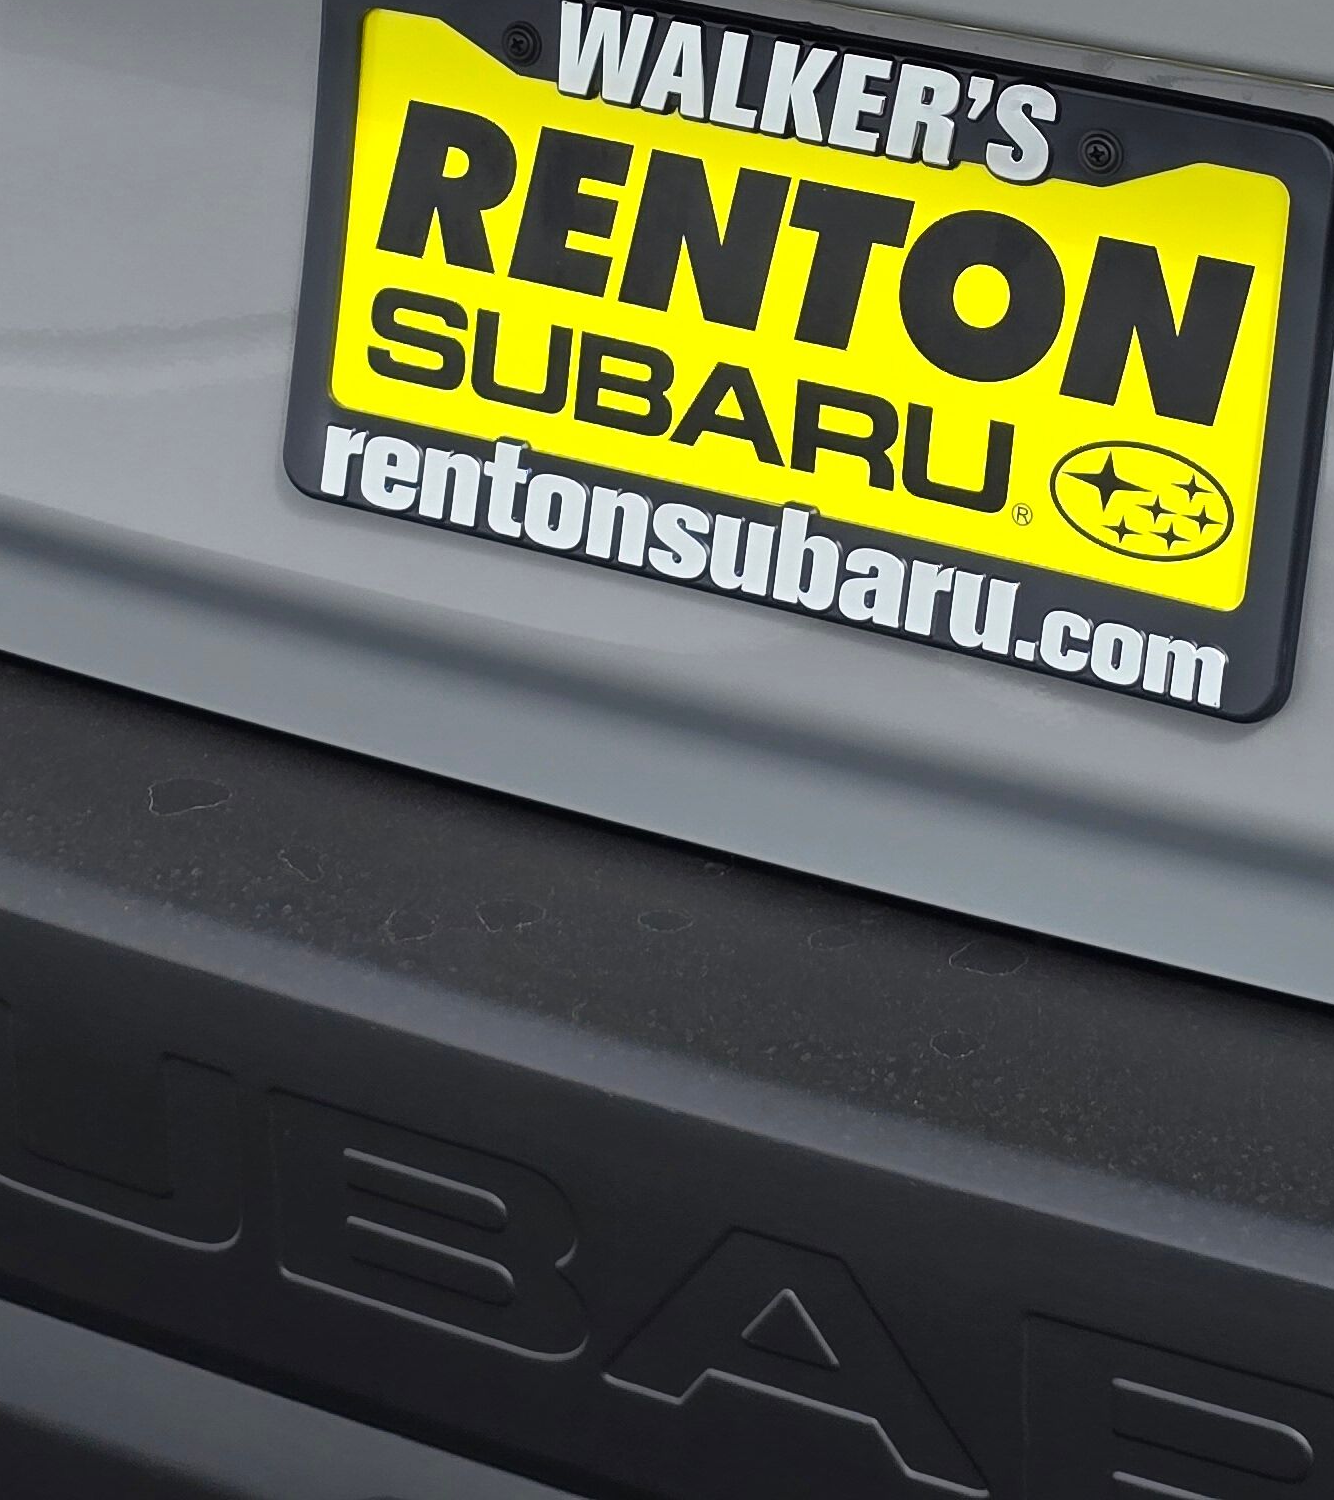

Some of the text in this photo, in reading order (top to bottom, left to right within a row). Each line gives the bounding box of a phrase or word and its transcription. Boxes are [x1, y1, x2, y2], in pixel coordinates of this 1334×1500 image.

[556, 0, 1058, 183] WALKER'S
[375, 100, 1255, 426] RENTON
[367, 288, 1015, 514] SUBARU
[318, 424, 1229, 710] rentonsubaru.com
